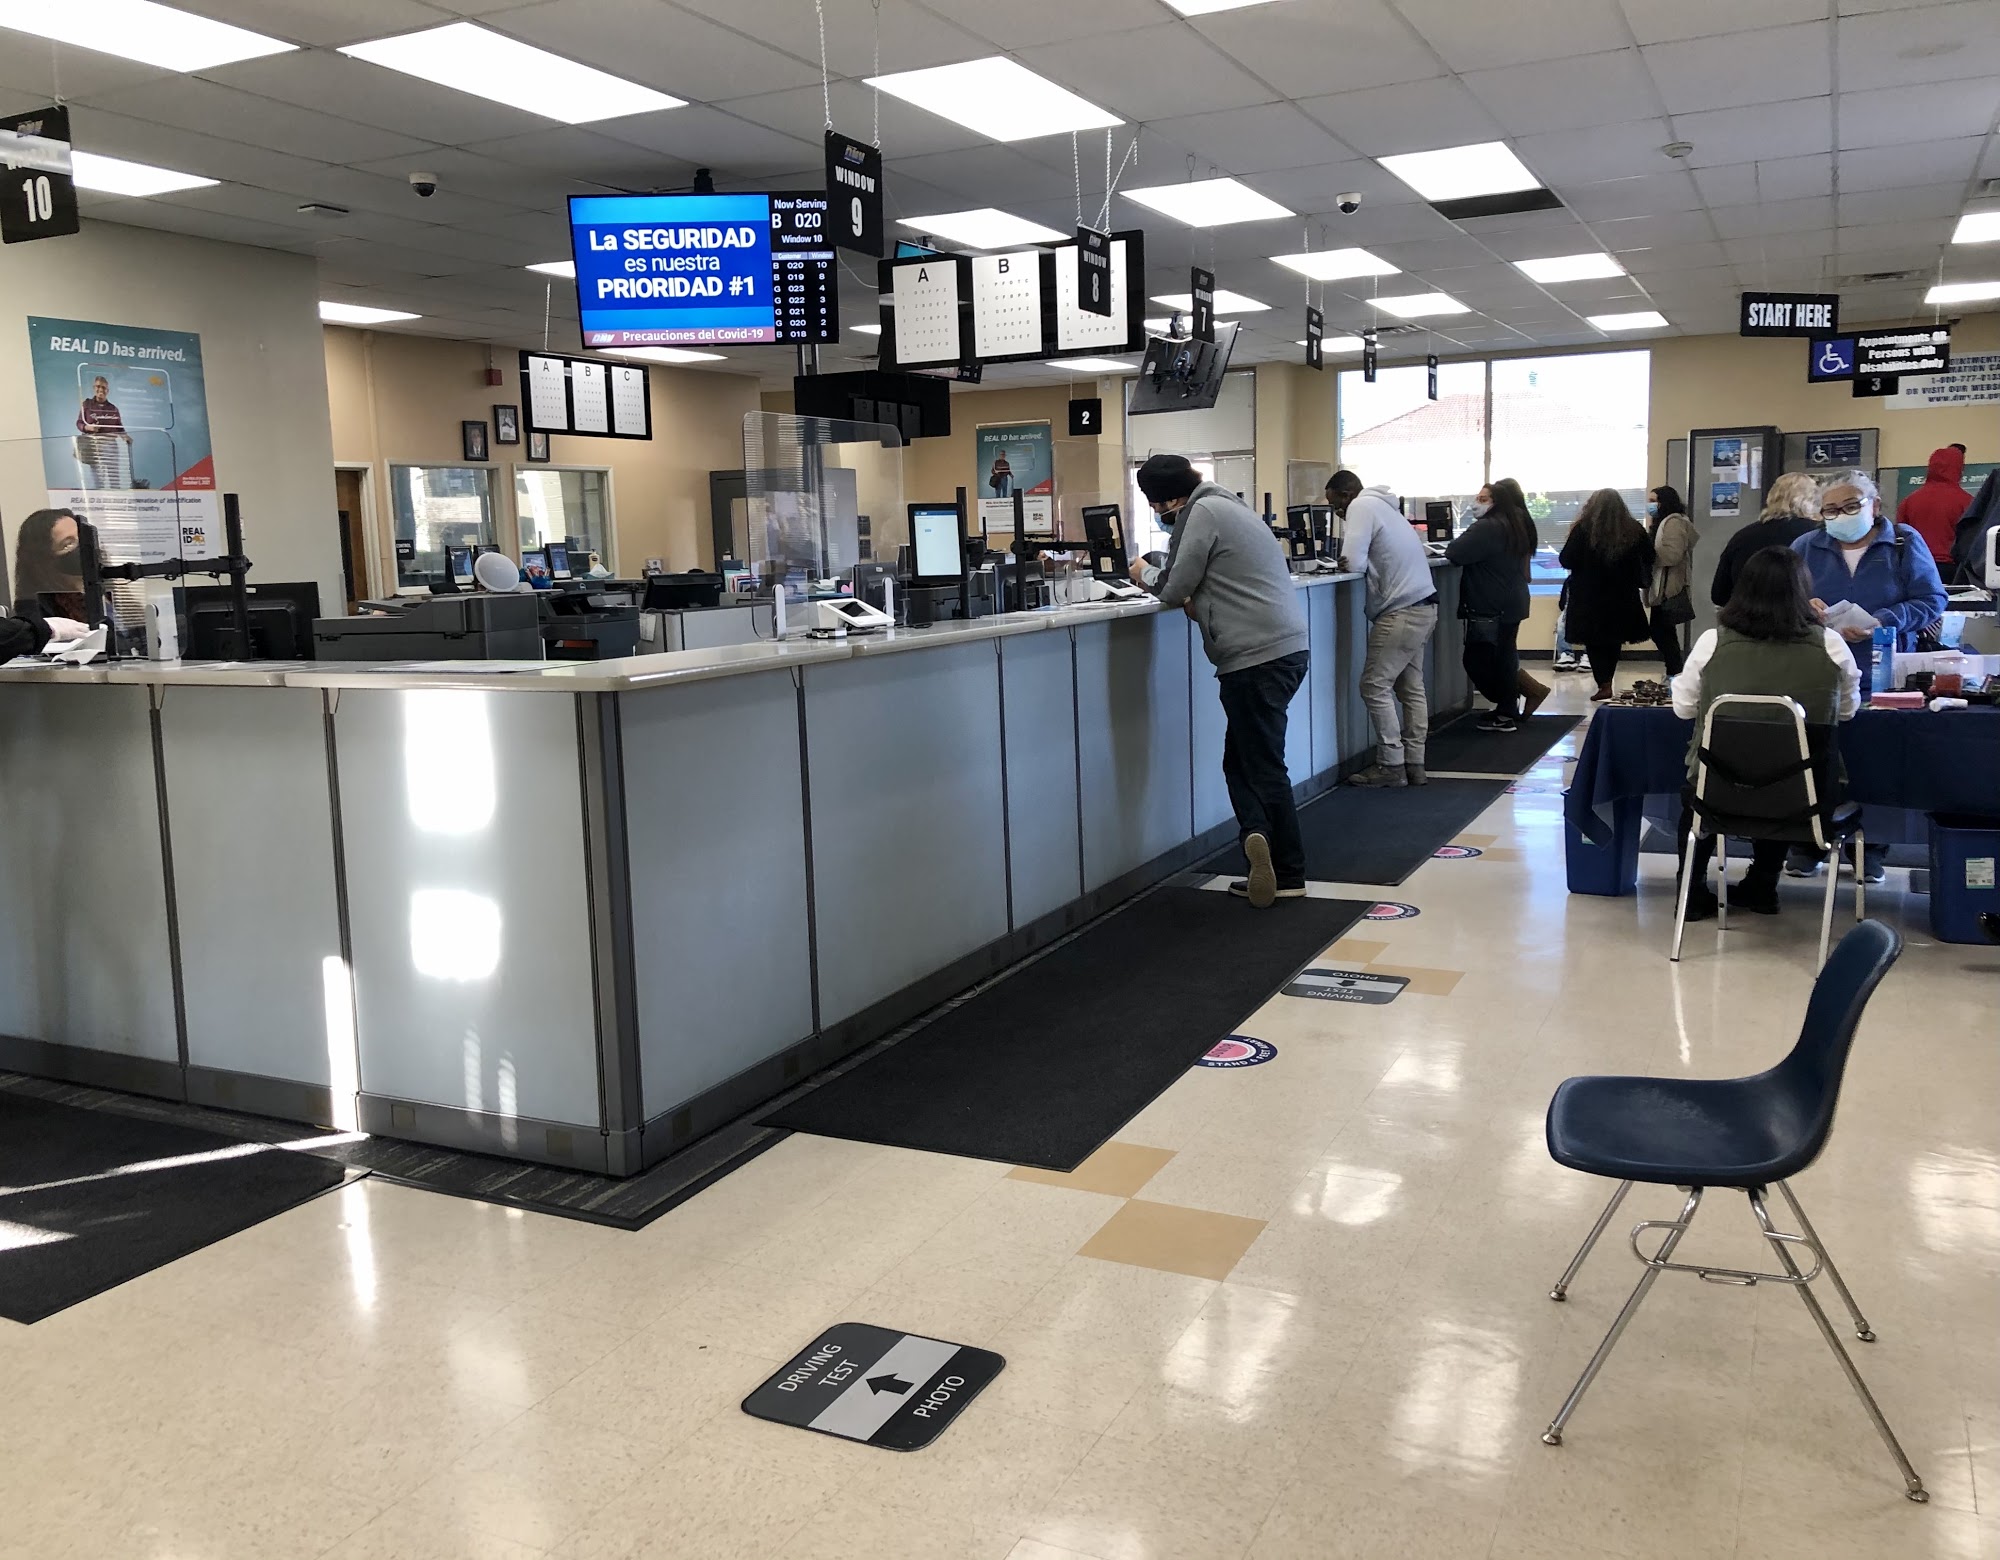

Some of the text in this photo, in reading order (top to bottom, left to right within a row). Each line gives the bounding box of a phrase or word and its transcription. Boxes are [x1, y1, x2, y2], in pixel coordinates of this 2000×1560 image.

[835, 165, 875, 193] WINDOW
[22, 175, 53, 222] 10
[774, 198, 827, 210] Now Serving
[772, 212, 822, 228] B 020
[851, 196, 863, 237] 9
[589, 227, 756, 250] La SEGURIDAD
[781, 234, 822, 244] Window 10
[624, 254, 720, 272] es nuestra
[998, 258, 1010, 274] B
[1083, 249, 1107, 270] WINDOW
[918, 268, 929, 283] A
[597, 276, 754, 298] PRIORIDAD #1
[1092, 272, 1100, 302] 8
[1748, 302, 1832, 328] START HERE
[622, 330, 696, 342] Precauciones
[698, 328, 715, 340] del
[717, 328, 764, 340] Covid-19
[1858, 333, 1930, 347] Appointments
[50, 336, 186, 362] REAL ID has arrived.
[1868, 346, 1936, 359] Persons with
[543, 361, 550, 372] A
[585, 366, 591, 376] B
[624, 371, 630, 381] C
[1871, 378, 1881, 391] 3
[1082, 410, 1090, 425] 2
[183, 536, 193, 544] ID
[1332, 972, 1378, 980] PHOTO
[1307, 991, 1364, 1000] DRIVING
[778, 1343, 842, 1392] DRIVING
[818, 1359, 858, 1387] TEST
[913, 1375, 965, 1418] PHOTO
